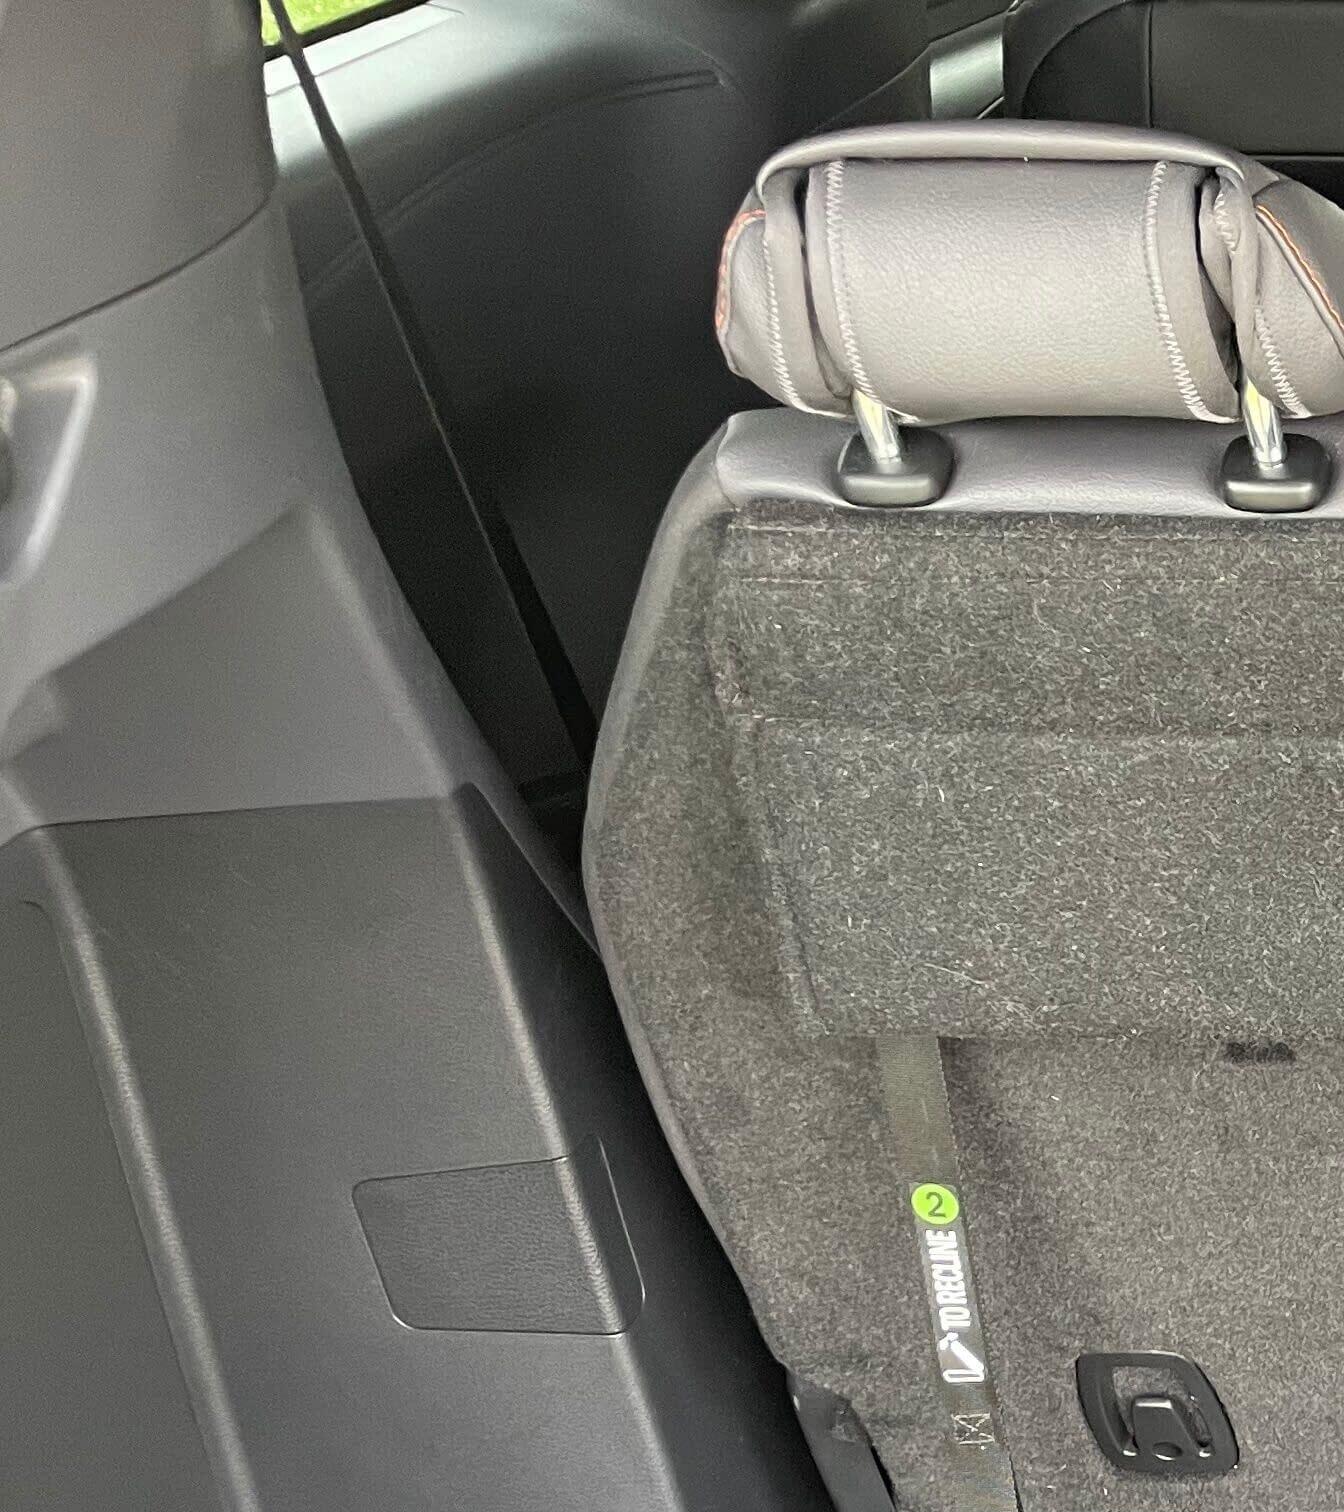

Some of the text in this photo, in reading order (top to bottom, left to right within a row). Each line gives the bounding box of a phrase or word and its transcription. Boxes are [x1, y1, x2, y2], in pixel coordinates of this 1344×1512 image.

[925, 1192, 946, 1217] 2
[925, 1230, 971, 1331] TO RECLINE
